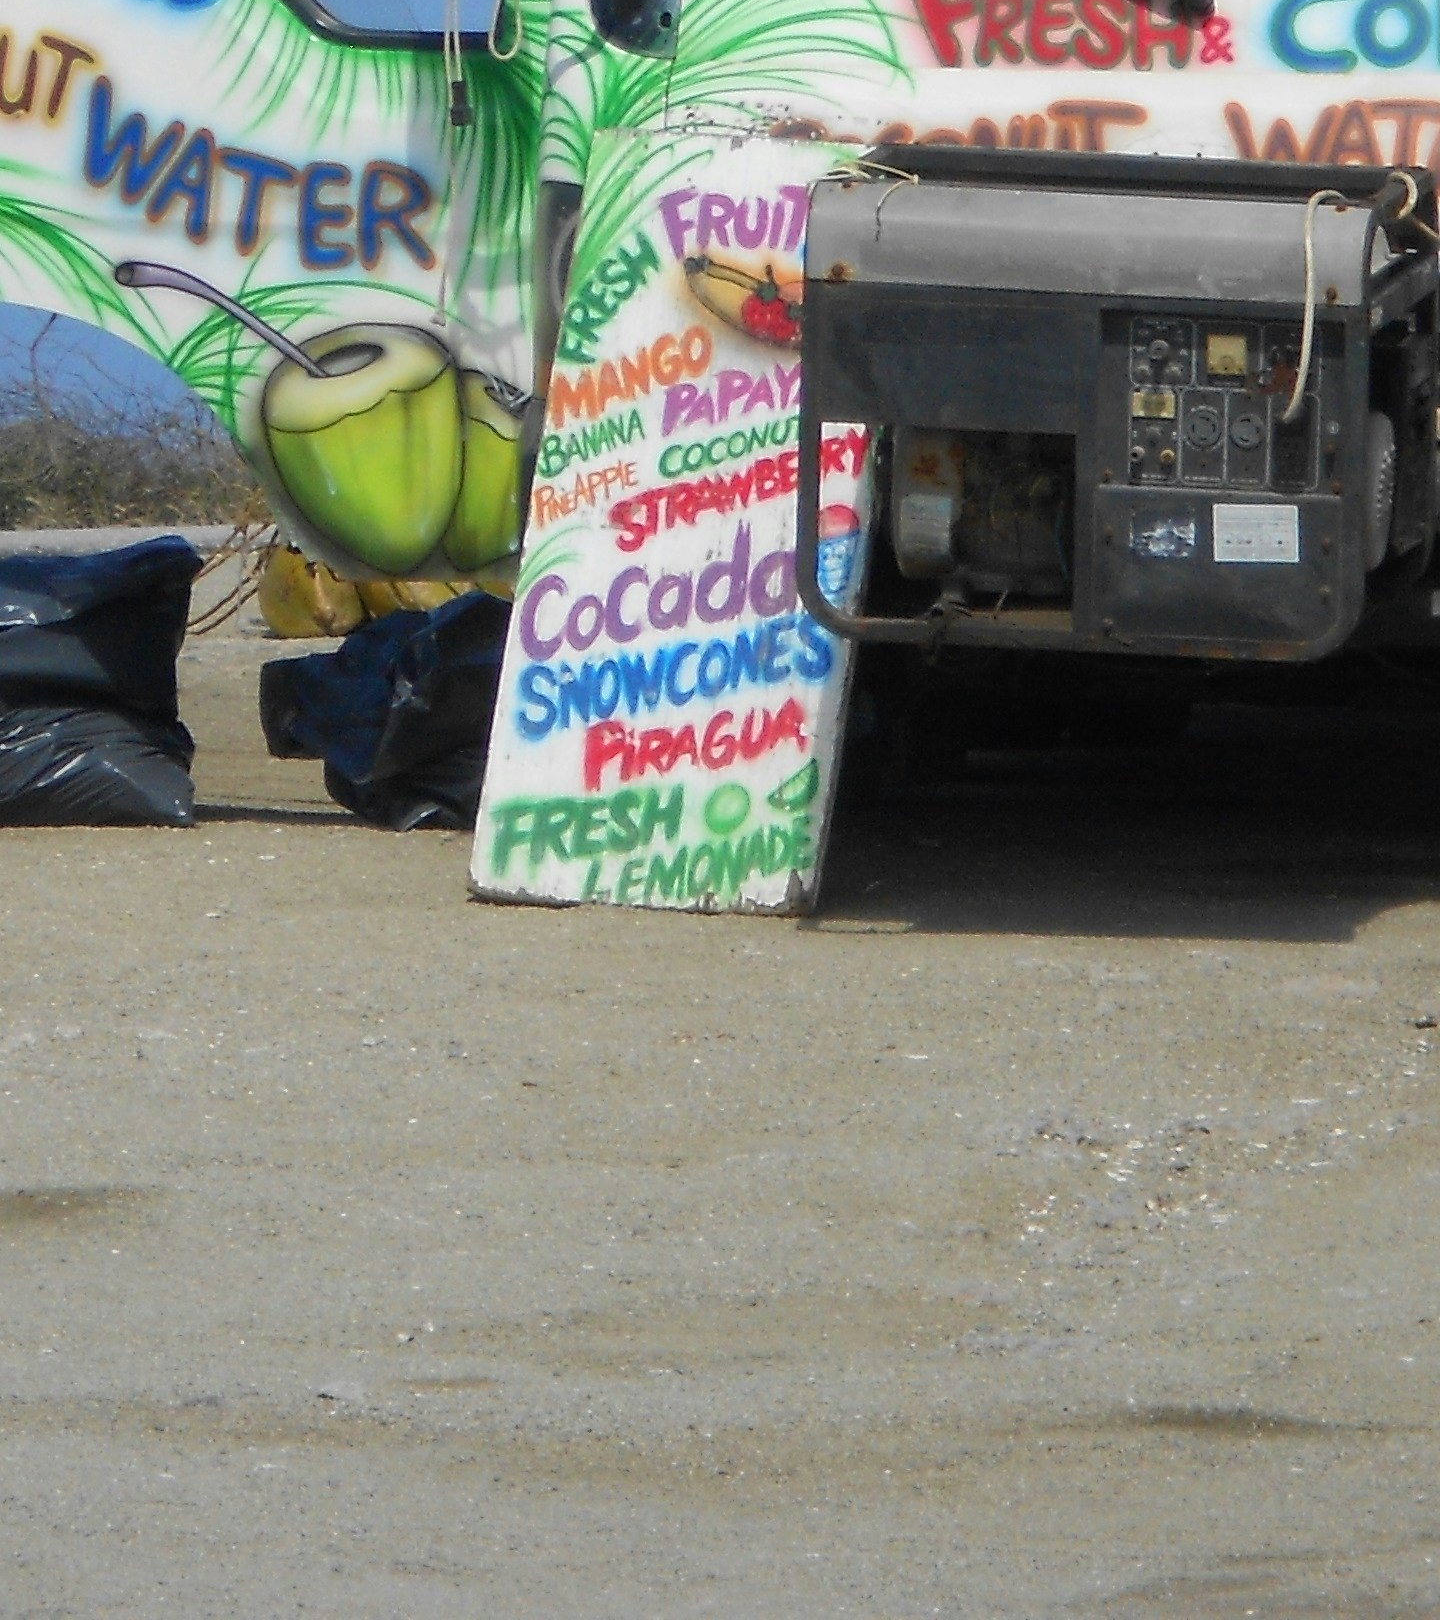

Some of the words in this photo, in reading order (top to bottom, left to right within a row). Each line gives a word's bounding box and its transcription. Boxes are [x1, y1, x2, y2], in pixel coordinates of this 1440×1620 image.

[83, 75, 437, 272] WATER
[560, 230, 661, 365] FRESH
[550, 325, 712, 429] MANGO
[661, 362, 802, 436] PAPAY
[539, 408, 646, 478] BANANA
[609, 427, 871, 552] STRAWBERY
[516, 615, 833, 740] SNOWCONES
[491, 784, 685, 876] FRESH
[581, 816, 815, 902] LEMONADE
